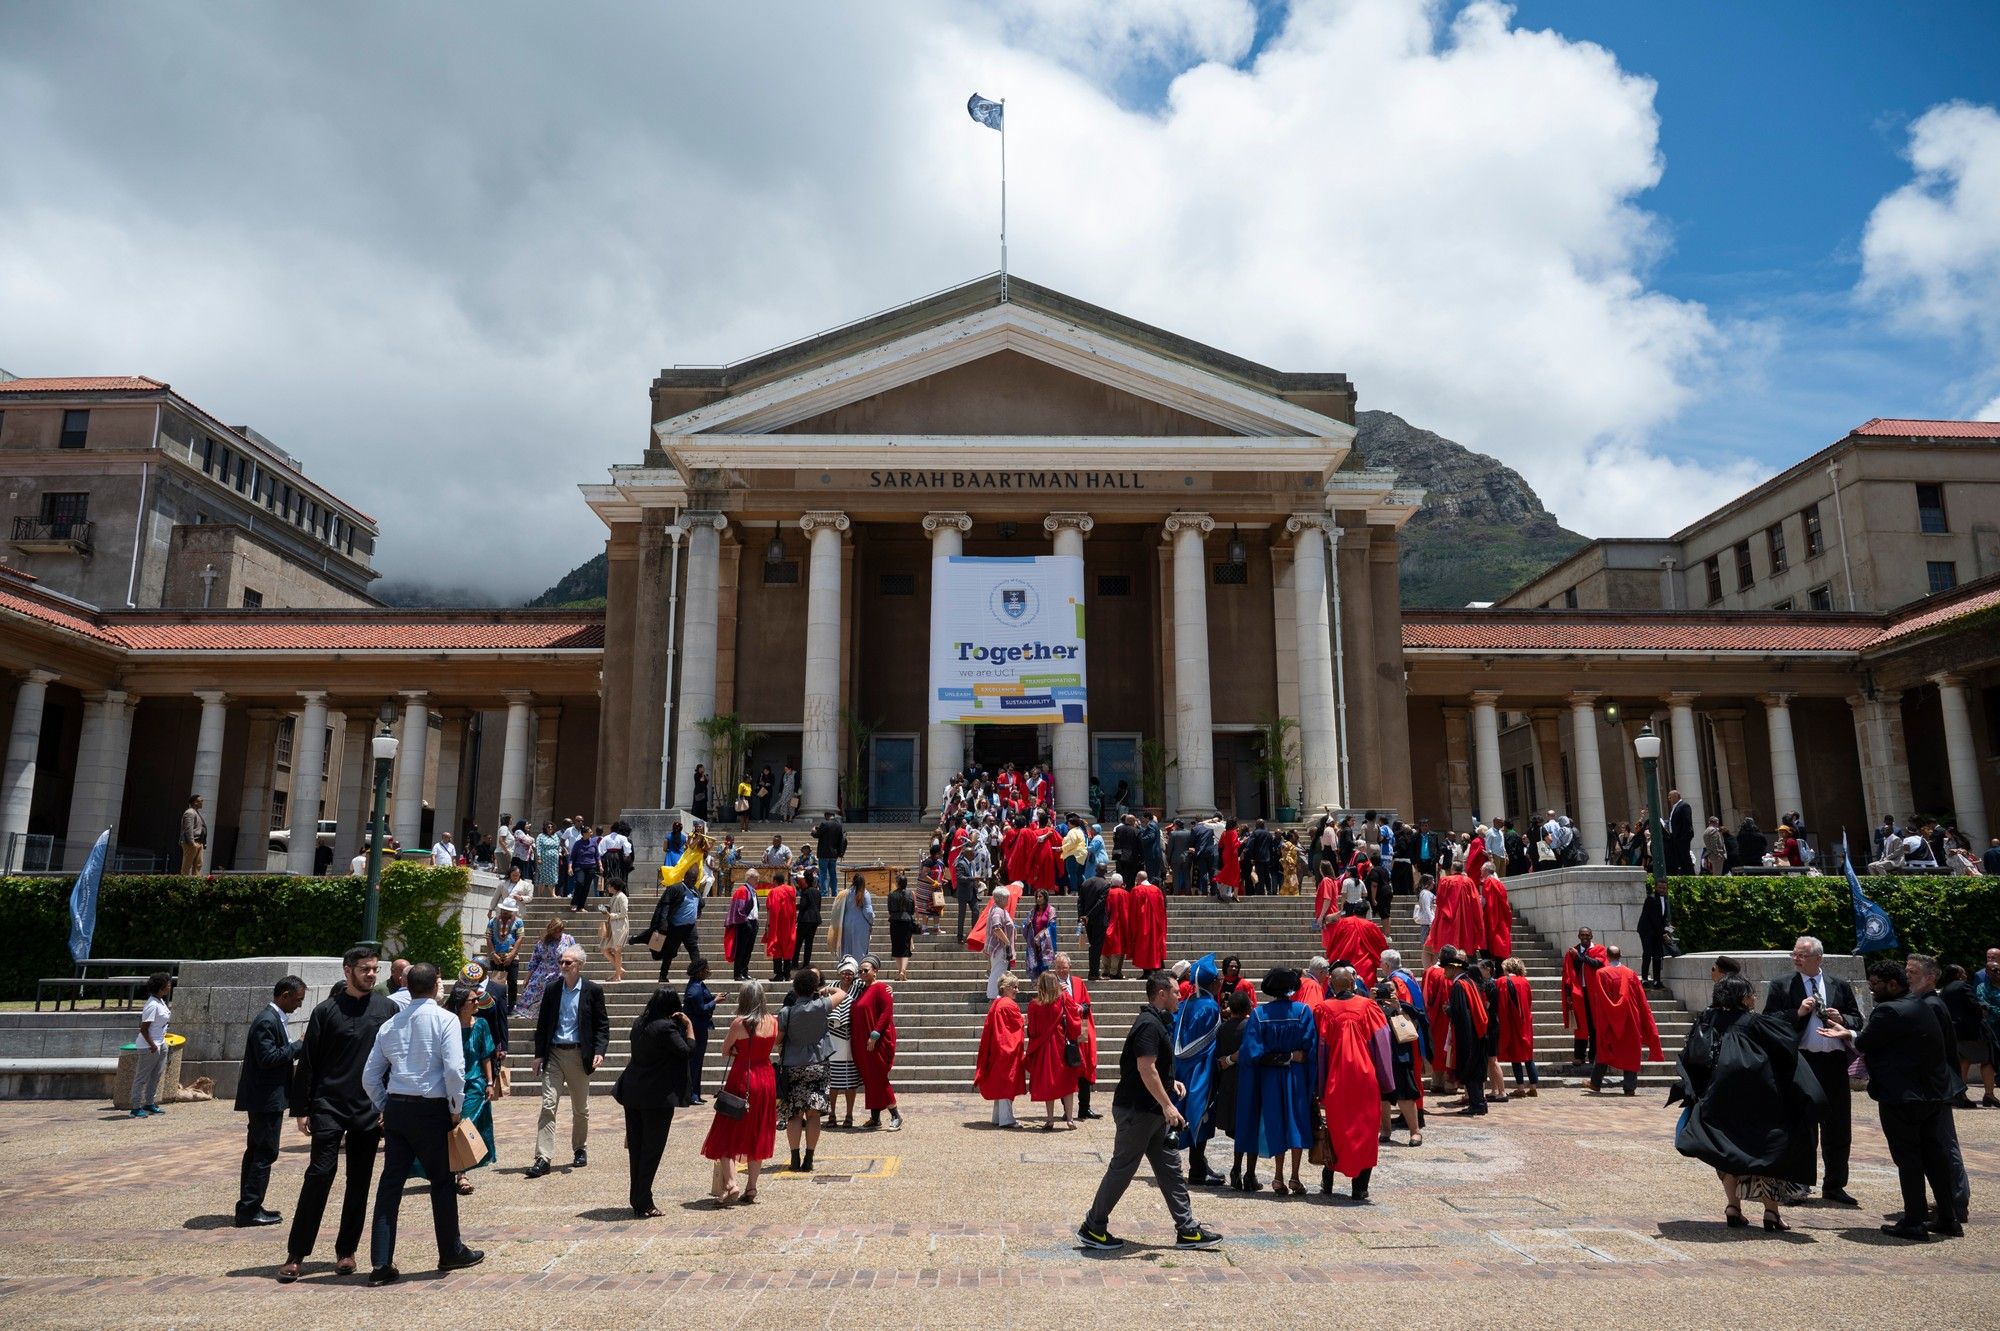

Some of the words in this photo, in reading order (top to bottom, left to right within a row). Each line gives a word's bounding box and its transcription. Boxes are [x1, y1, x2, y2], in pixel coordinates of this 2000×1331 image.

[870, 471, 945, 488] SARAH
[952, 471, 1078, 489] BAARTMAN
[1085, 472, 1144, 489] HALL
[954, 641, 1078, 665] Together
[995, 668, 1016, 677] UCT
[1025, 677, 1077, 685] TRANSFORMATION
[1005, 698, 1051, 706] SUSTAINABILITY
